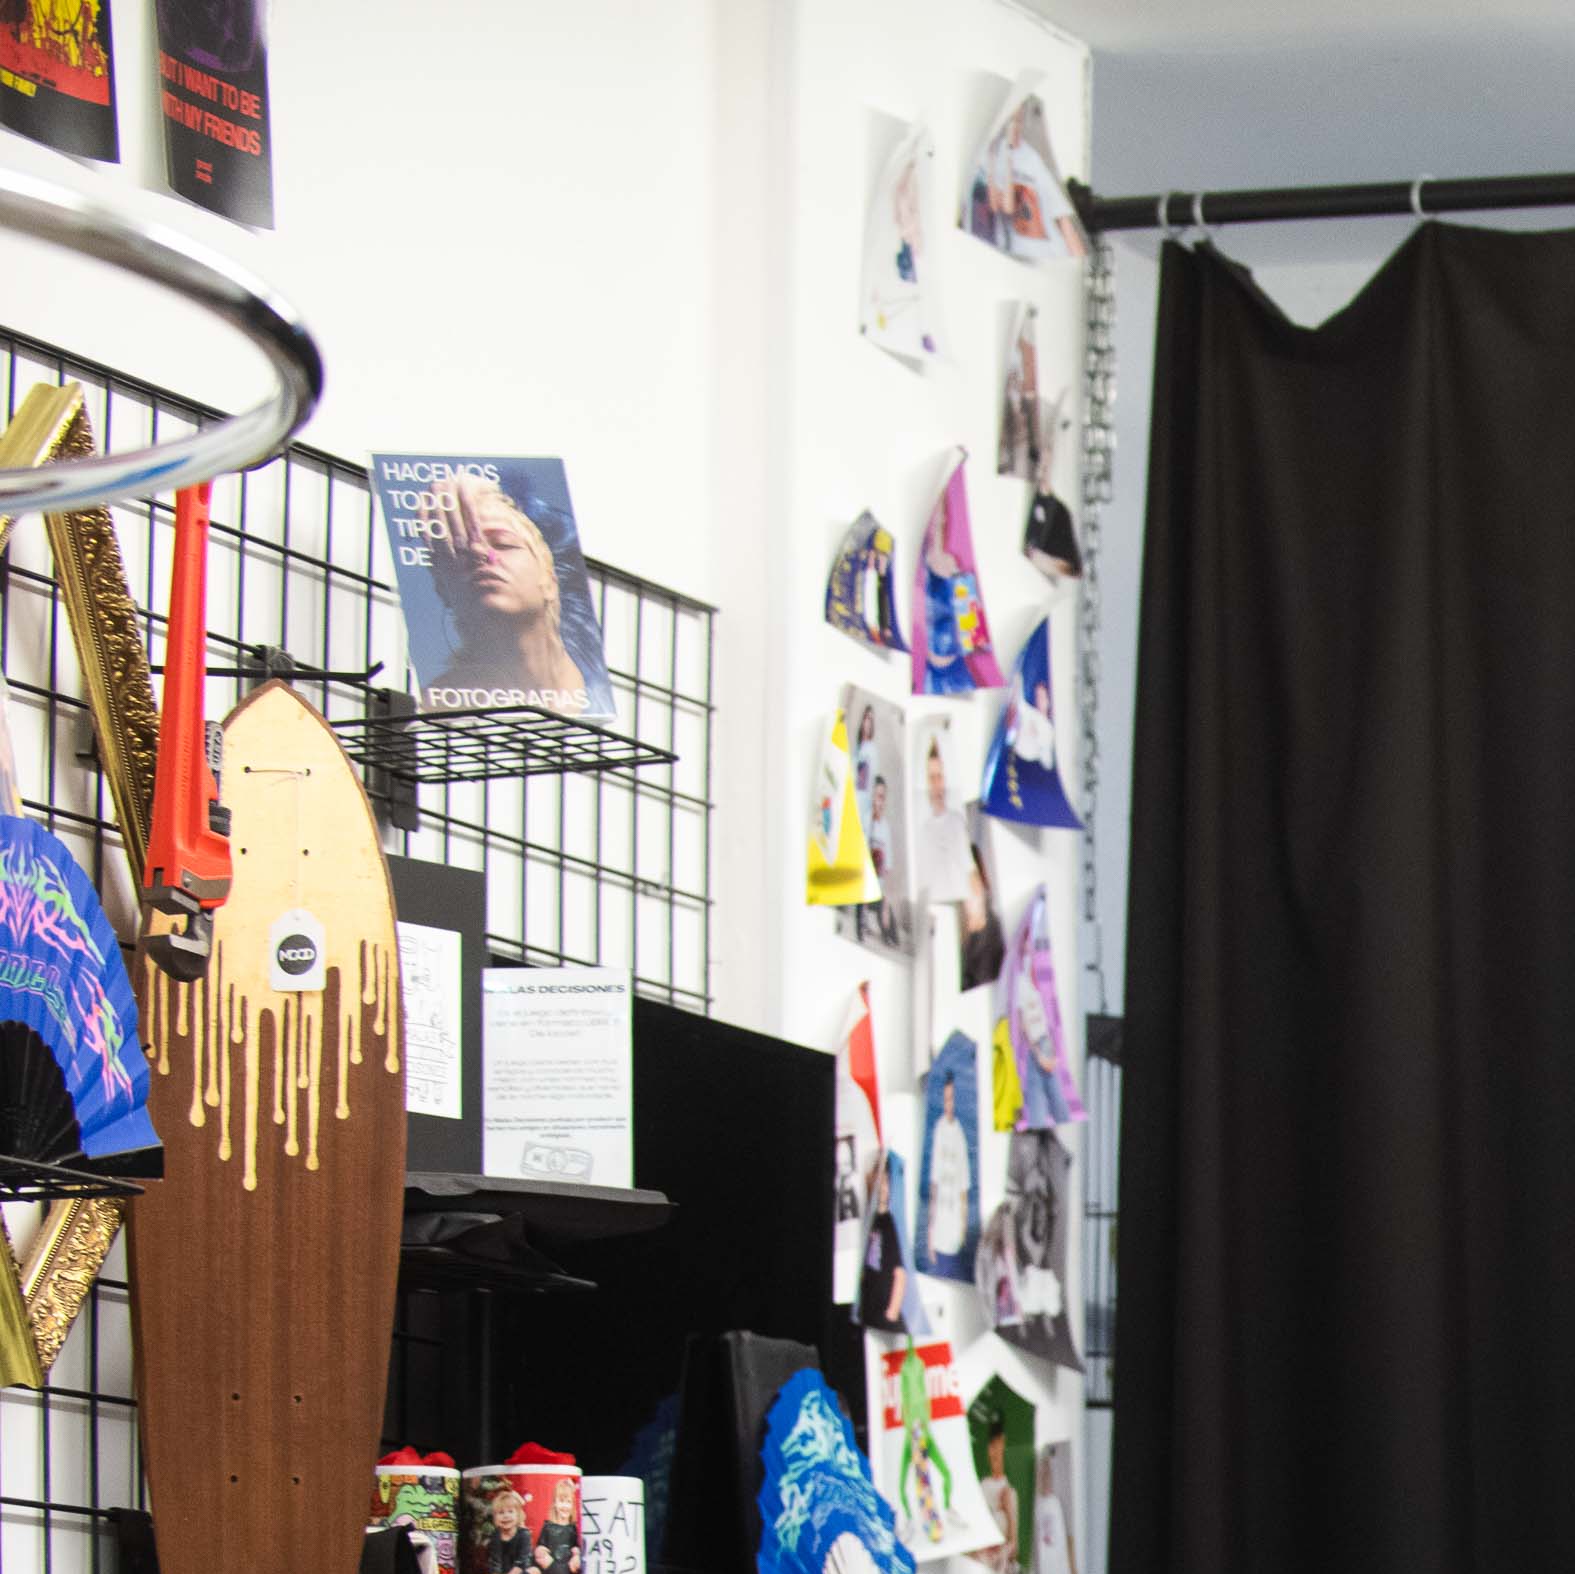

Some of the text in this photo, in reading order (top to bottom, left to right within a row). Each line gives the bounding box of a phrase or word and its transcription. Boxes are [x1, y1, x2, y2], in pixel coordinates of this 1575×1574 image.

[184, 66, 218, 102] WANT
[221, 81, 239, 111] TO
[240, 90, 262, 120] BE
[184, 104, 203, 132] MY
[205, 112, 261, 156] FRIENDS
[381, 462, 500, 484] HACEMOS
[387, 490, 457, 511] TODO
[393, 518, 448, 539] TIPO
[399, 546, 433, 567] DE
[427, 688, 592, 709] FOTOGRAFIAS
[538, 984, 625, 994] DECISIONES
